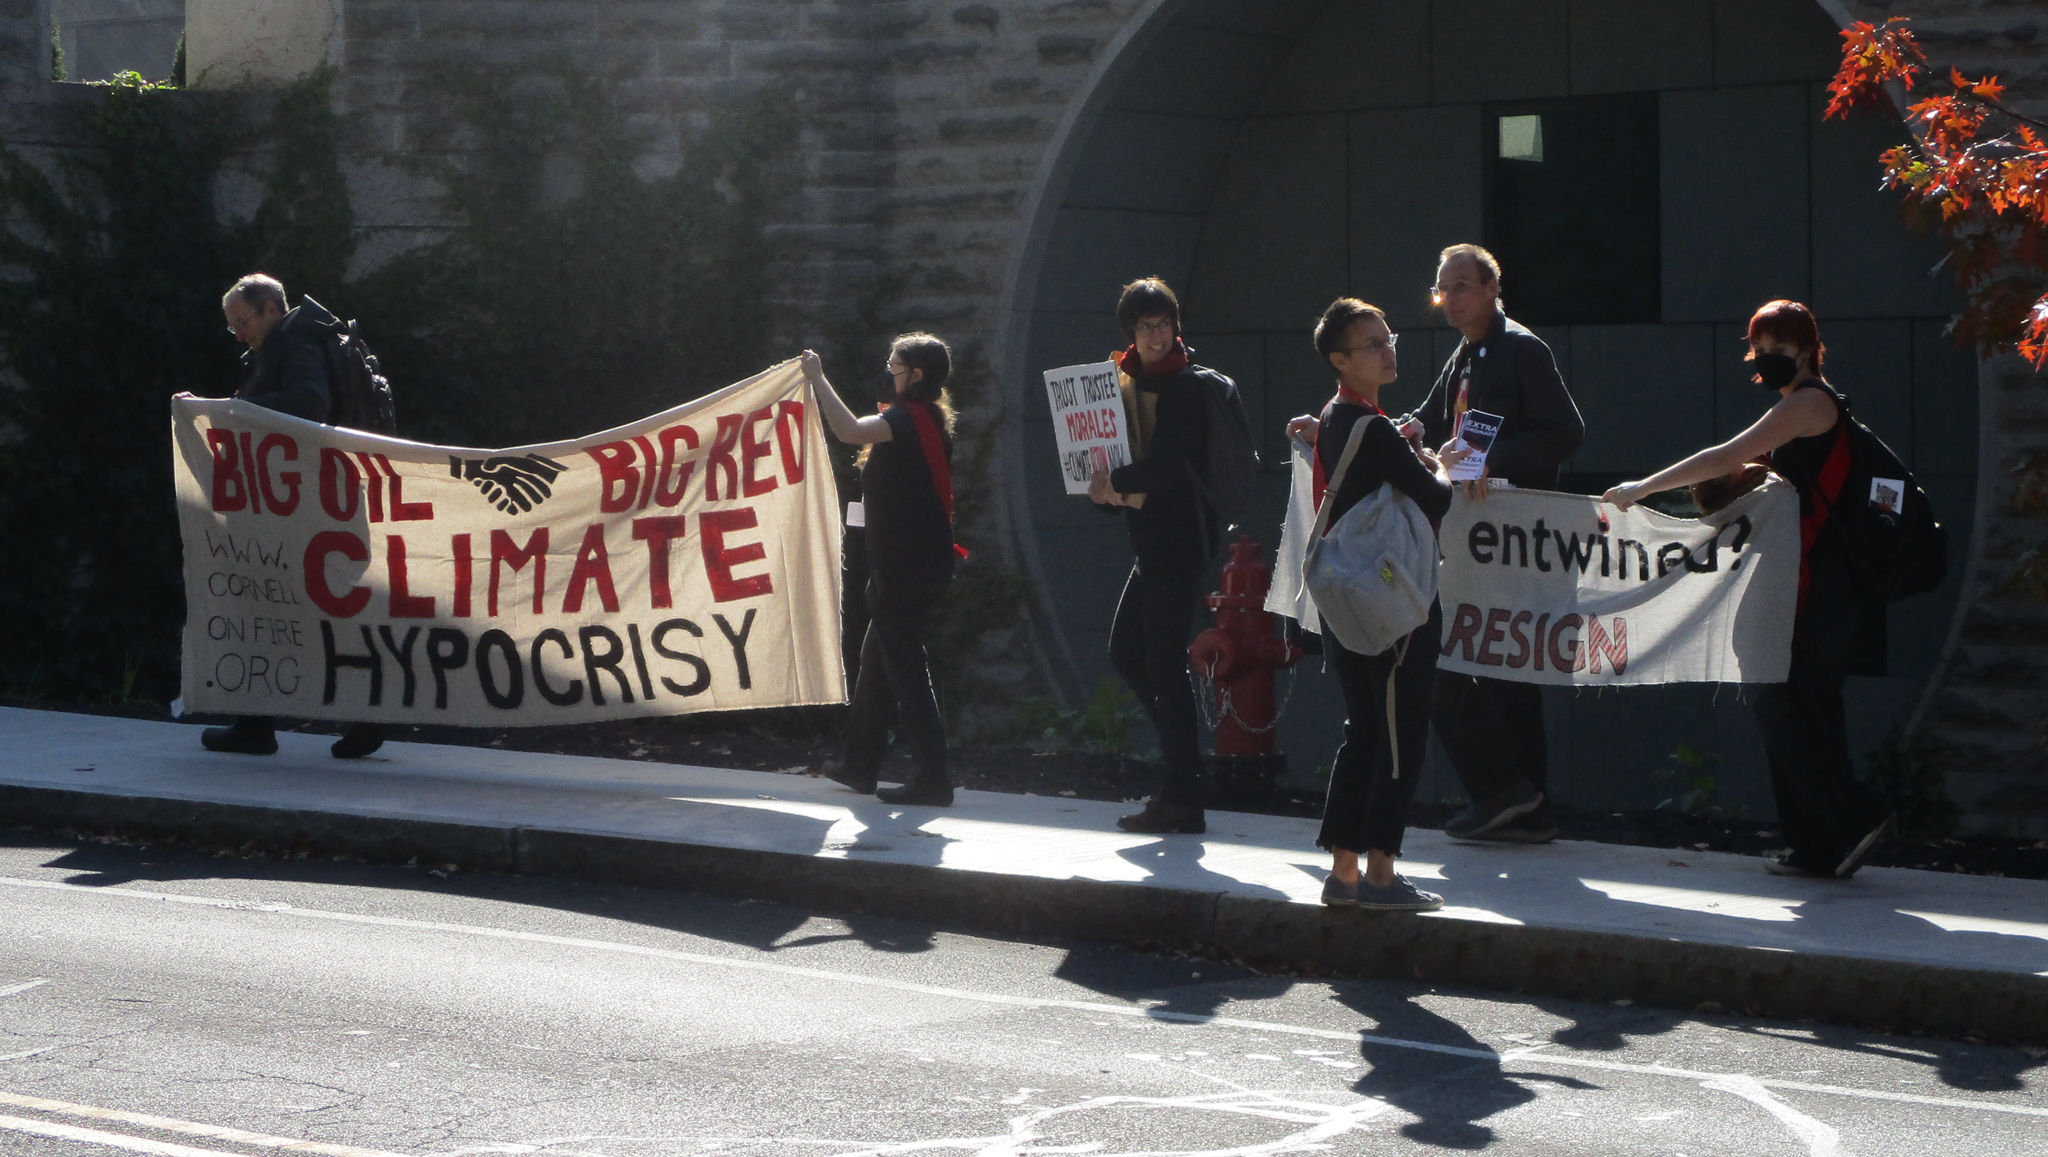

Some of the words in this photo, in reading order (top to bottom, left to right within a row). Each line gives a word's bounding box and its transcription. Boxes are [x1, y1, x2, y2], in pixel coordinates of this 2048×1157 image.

[1050, 377, 1079, 412] TRUST
[1080, 371, 1117, 404] TRUSTEE
[1065, 408, 1118, 442] MORALES
[1466, 420, 1498, 433] EXTRA
[206, 427, 302, 515] BIG
[319, 447, 434, 523] OIL
[583, 424, 700, 514] BIG
[704, 400, 805, 503] RED
[304, 507, 773, 619] CLIMATE
[208, 571, 301, 605] CORNELL
[208, 615, 245, 642] ON
[254, 616, 303, 647] FIRE
[1440, 603, 1628, 676] RESIGN
[206, 652, 303, 695] .ORG
[320, 608, 757, 710] HYPOCRISY
